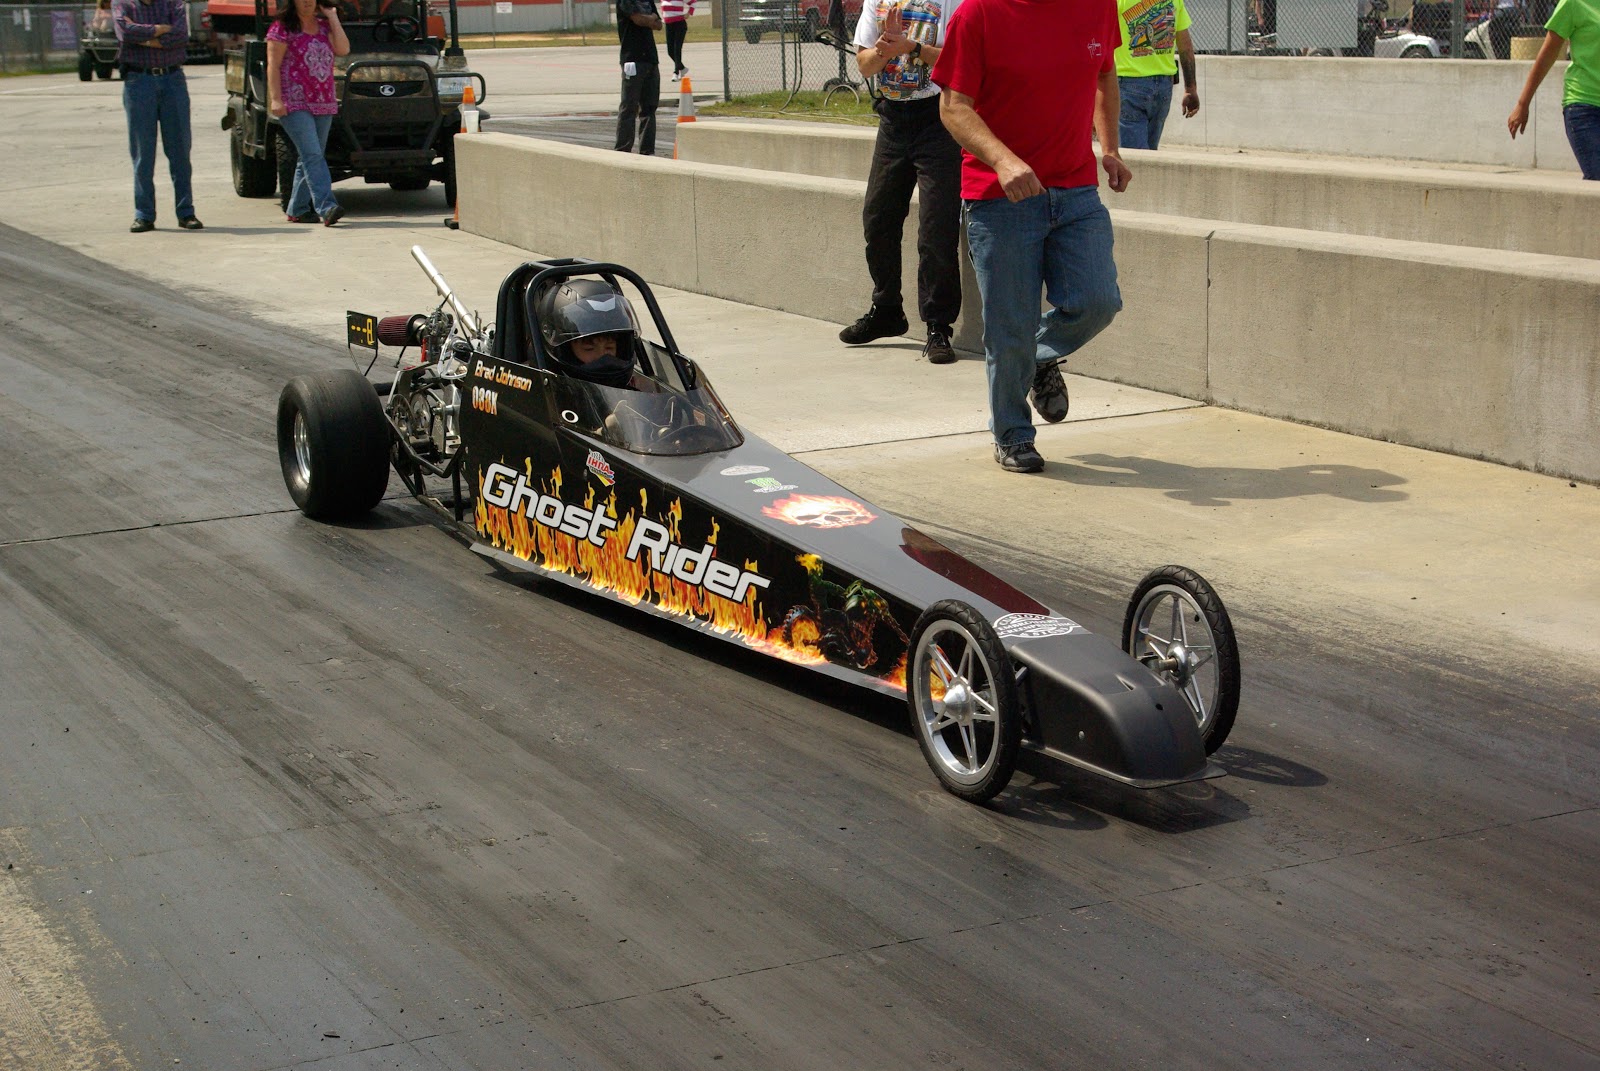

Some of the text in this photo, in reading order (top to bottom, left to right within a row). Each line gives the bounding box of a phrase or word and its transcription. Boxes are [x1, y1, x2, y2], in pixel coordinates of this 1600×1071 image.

[474, 360, 532, 391] Brad Johnson
[587, 456, 610, 474] IHRA
[482, 462, 771, 602] Ghost Rider
